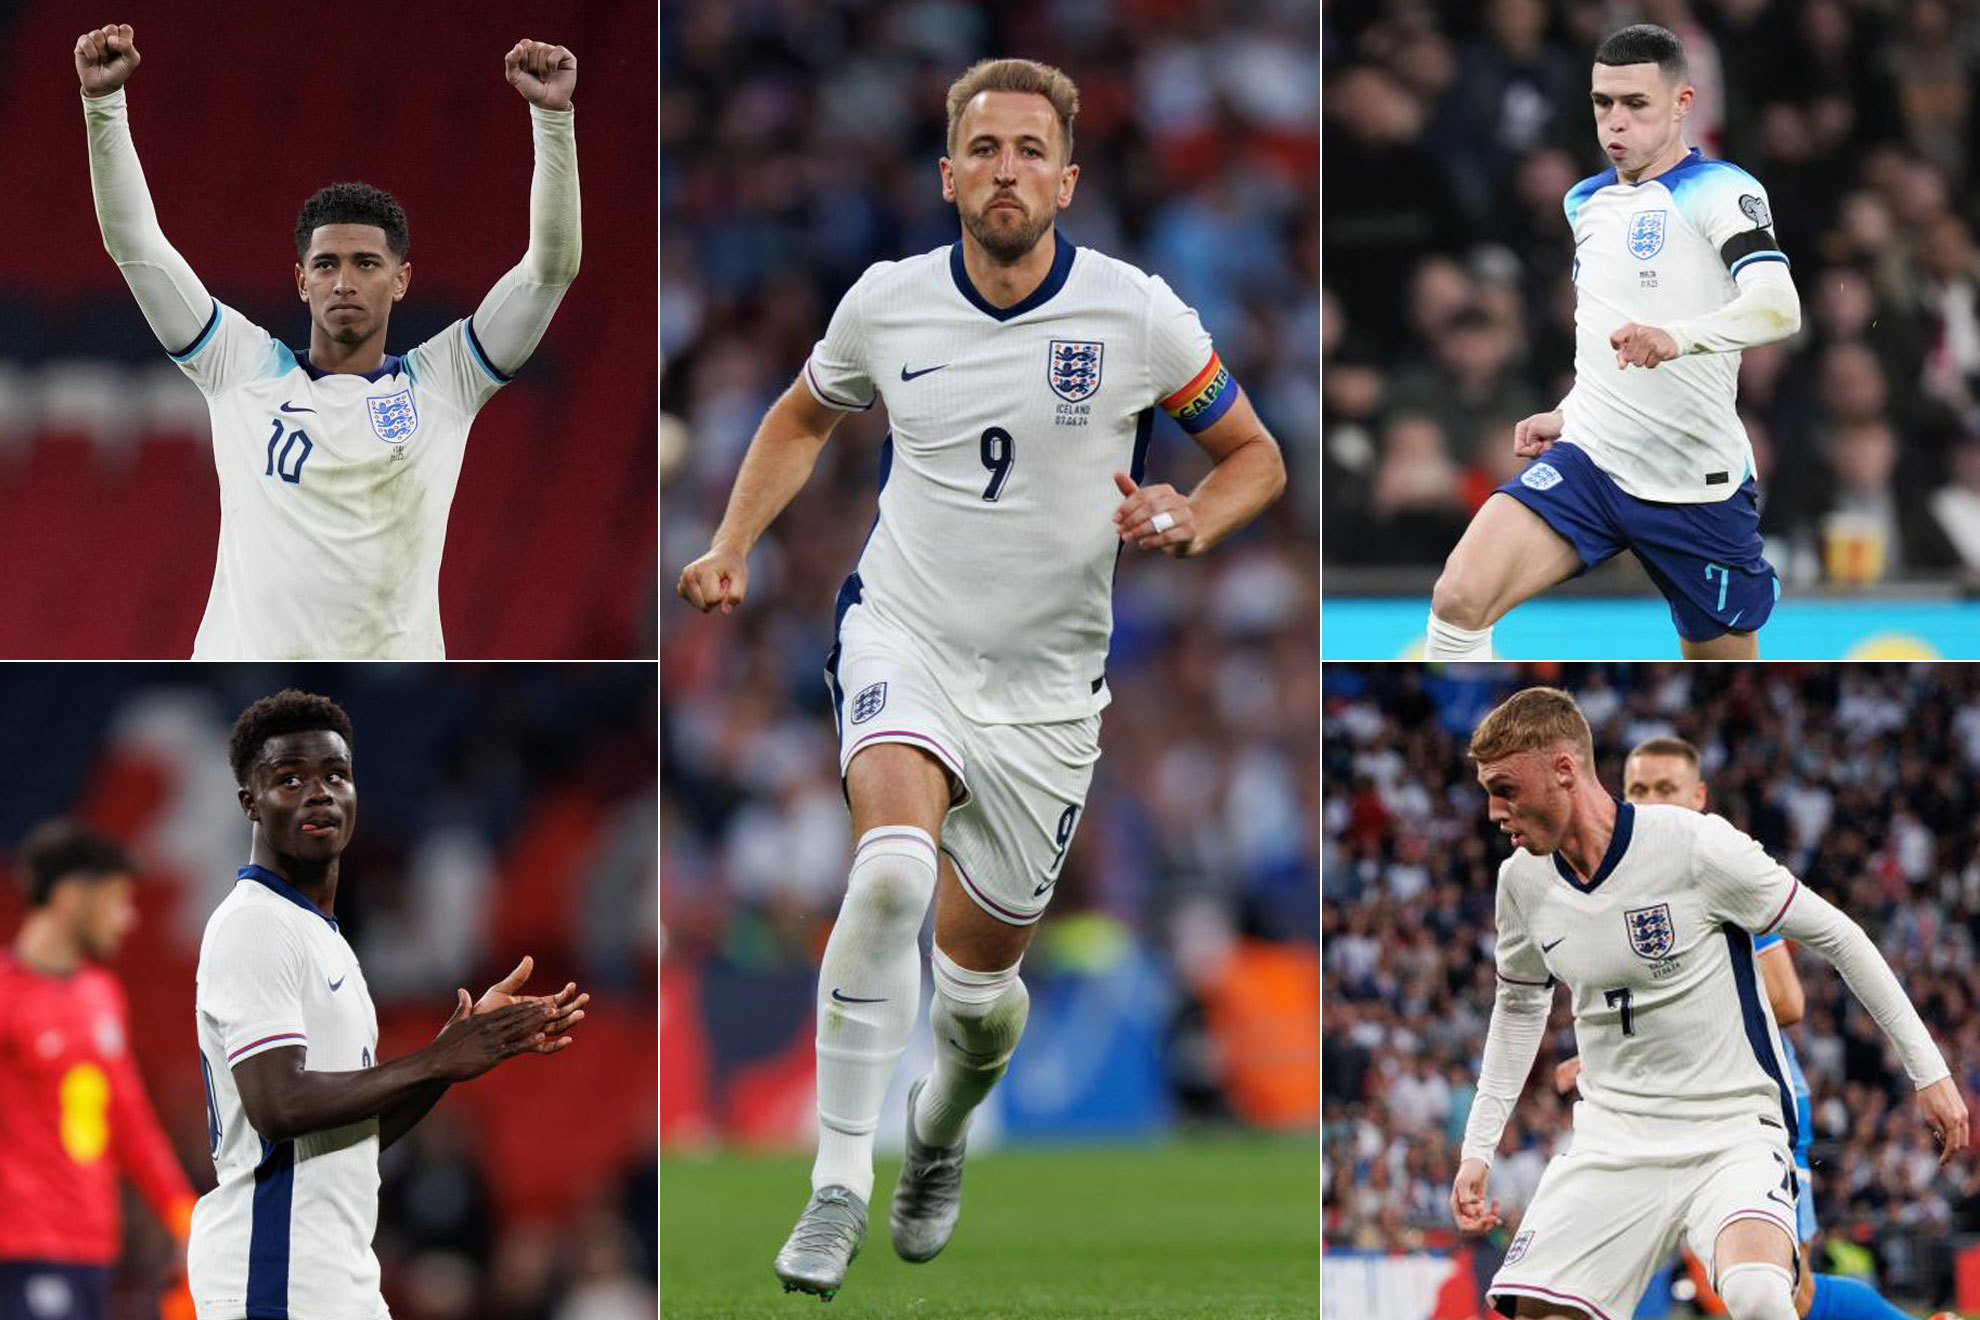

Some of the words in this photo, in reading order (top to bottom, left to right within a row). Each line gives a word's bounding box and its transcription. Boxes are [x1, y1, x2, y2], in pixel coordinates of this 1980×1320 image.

[1056, 403, 1091, 415] ICELAND
[265, 418, 314, 484] 10
[980, 426, 1016, 503] 9
[1704, 563, 1729, 612] 7
[1049, 804, 1078, 873] 9
[1603, 987, 1635, 1037] 7
